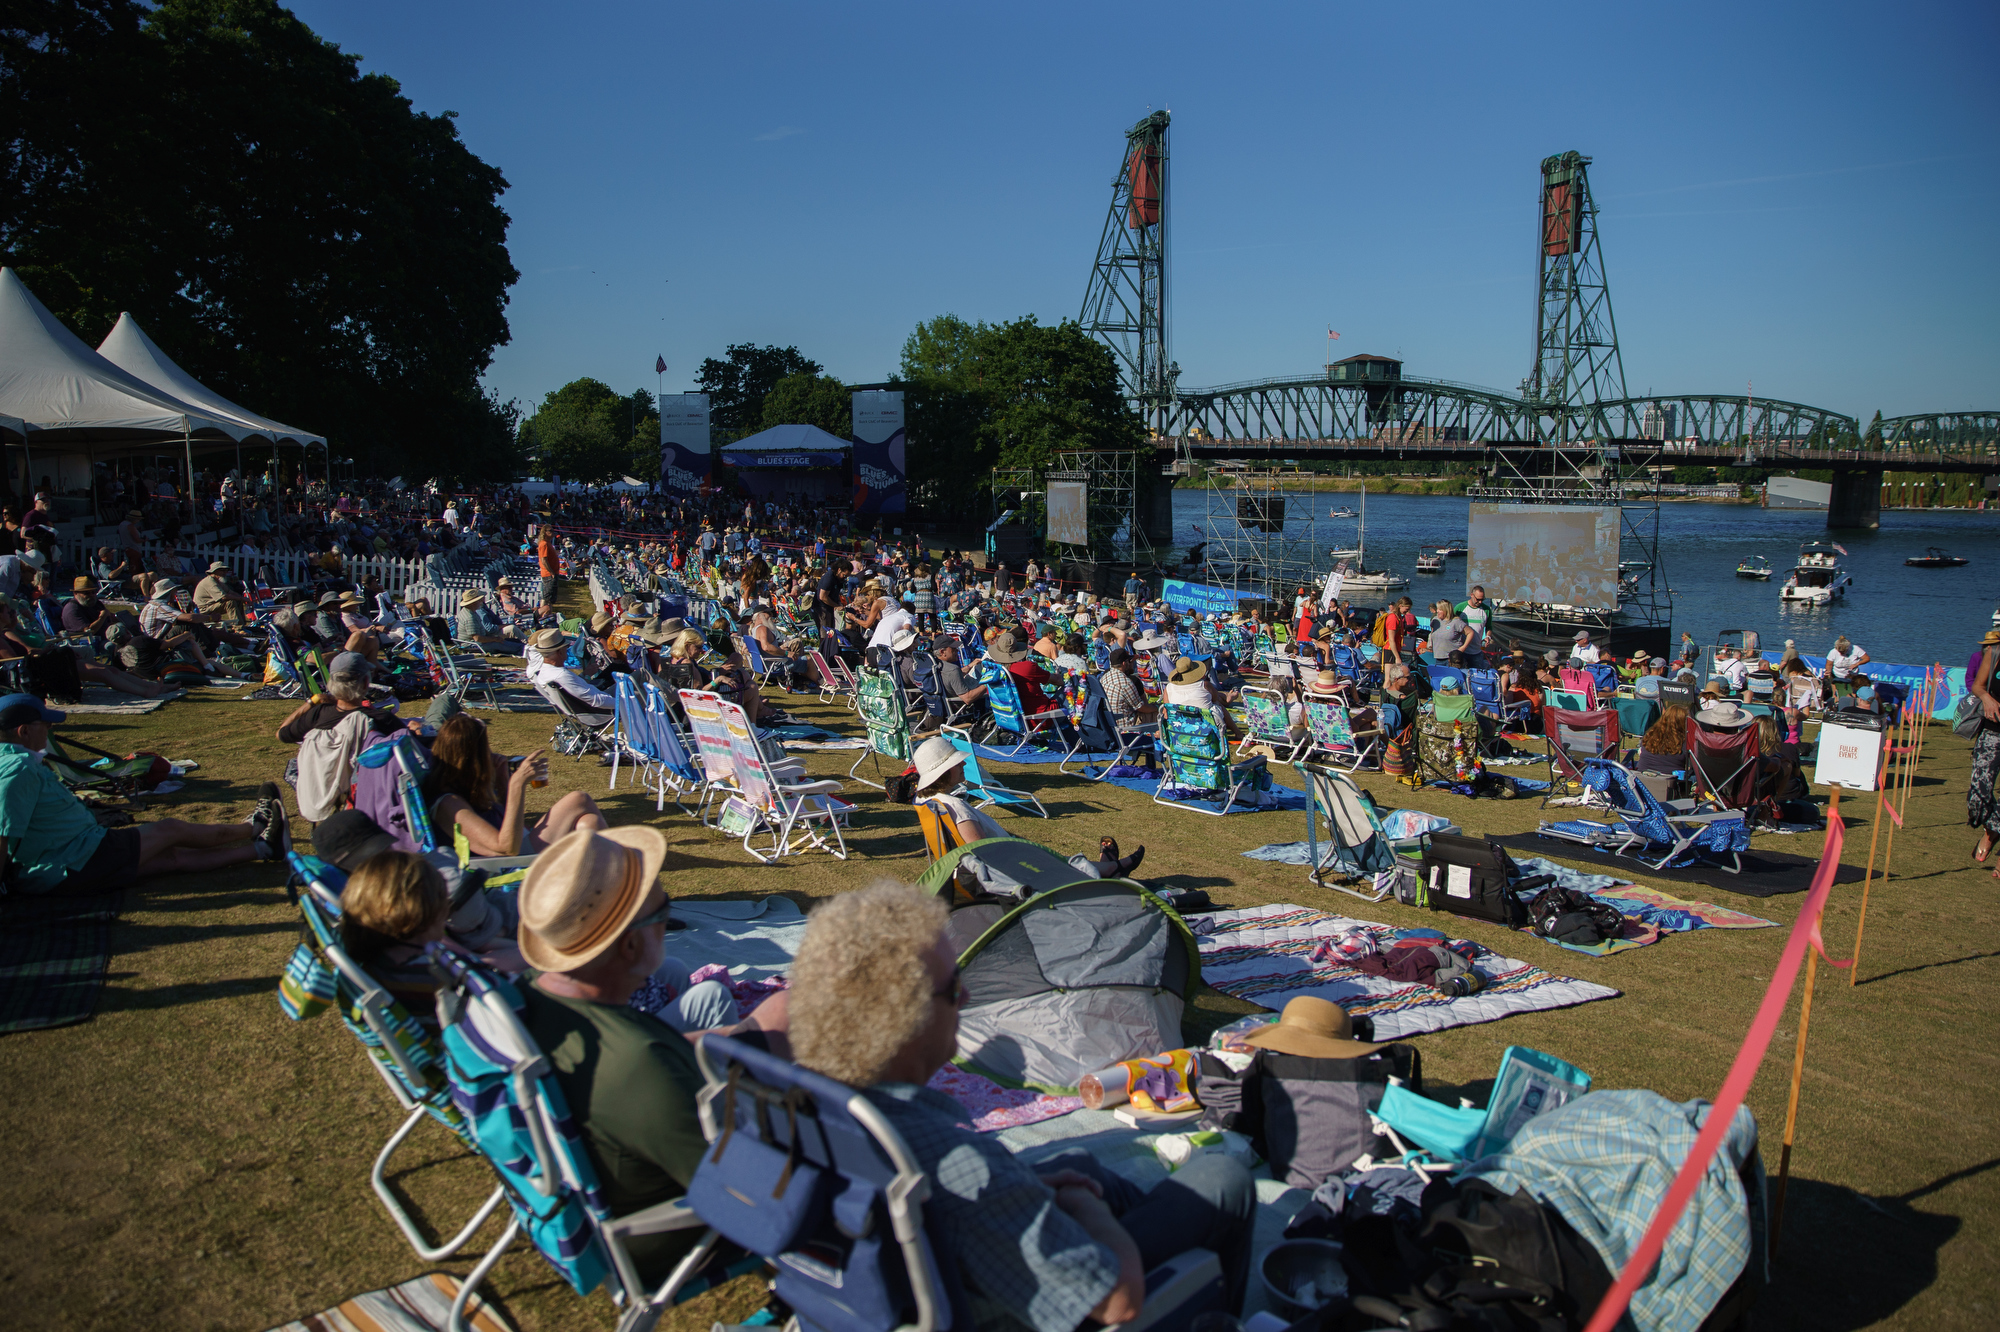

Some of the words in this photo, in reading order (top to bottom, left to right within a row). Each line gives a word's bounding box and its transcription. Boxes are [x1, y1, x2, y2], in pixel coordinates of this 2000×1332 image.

[757, 457, 783, 465] BLUES
[784, 457, 810, 465] STAGE
[667, 468, 694, 481] BLUES
[860, 467, 887, 480] BLUES
[668, 476, 705, 491] FESTIVAL
[860, 474, 899, 490] FESTIVAL
[1209, 591, 1215, 599] to
[1216, 592, 1226, 600] the
[1202, 599, 1225, 612] BUES
[1839, 744, 1858, 753] FULLER
[1838, 751, 1858, 760] EVENTS
